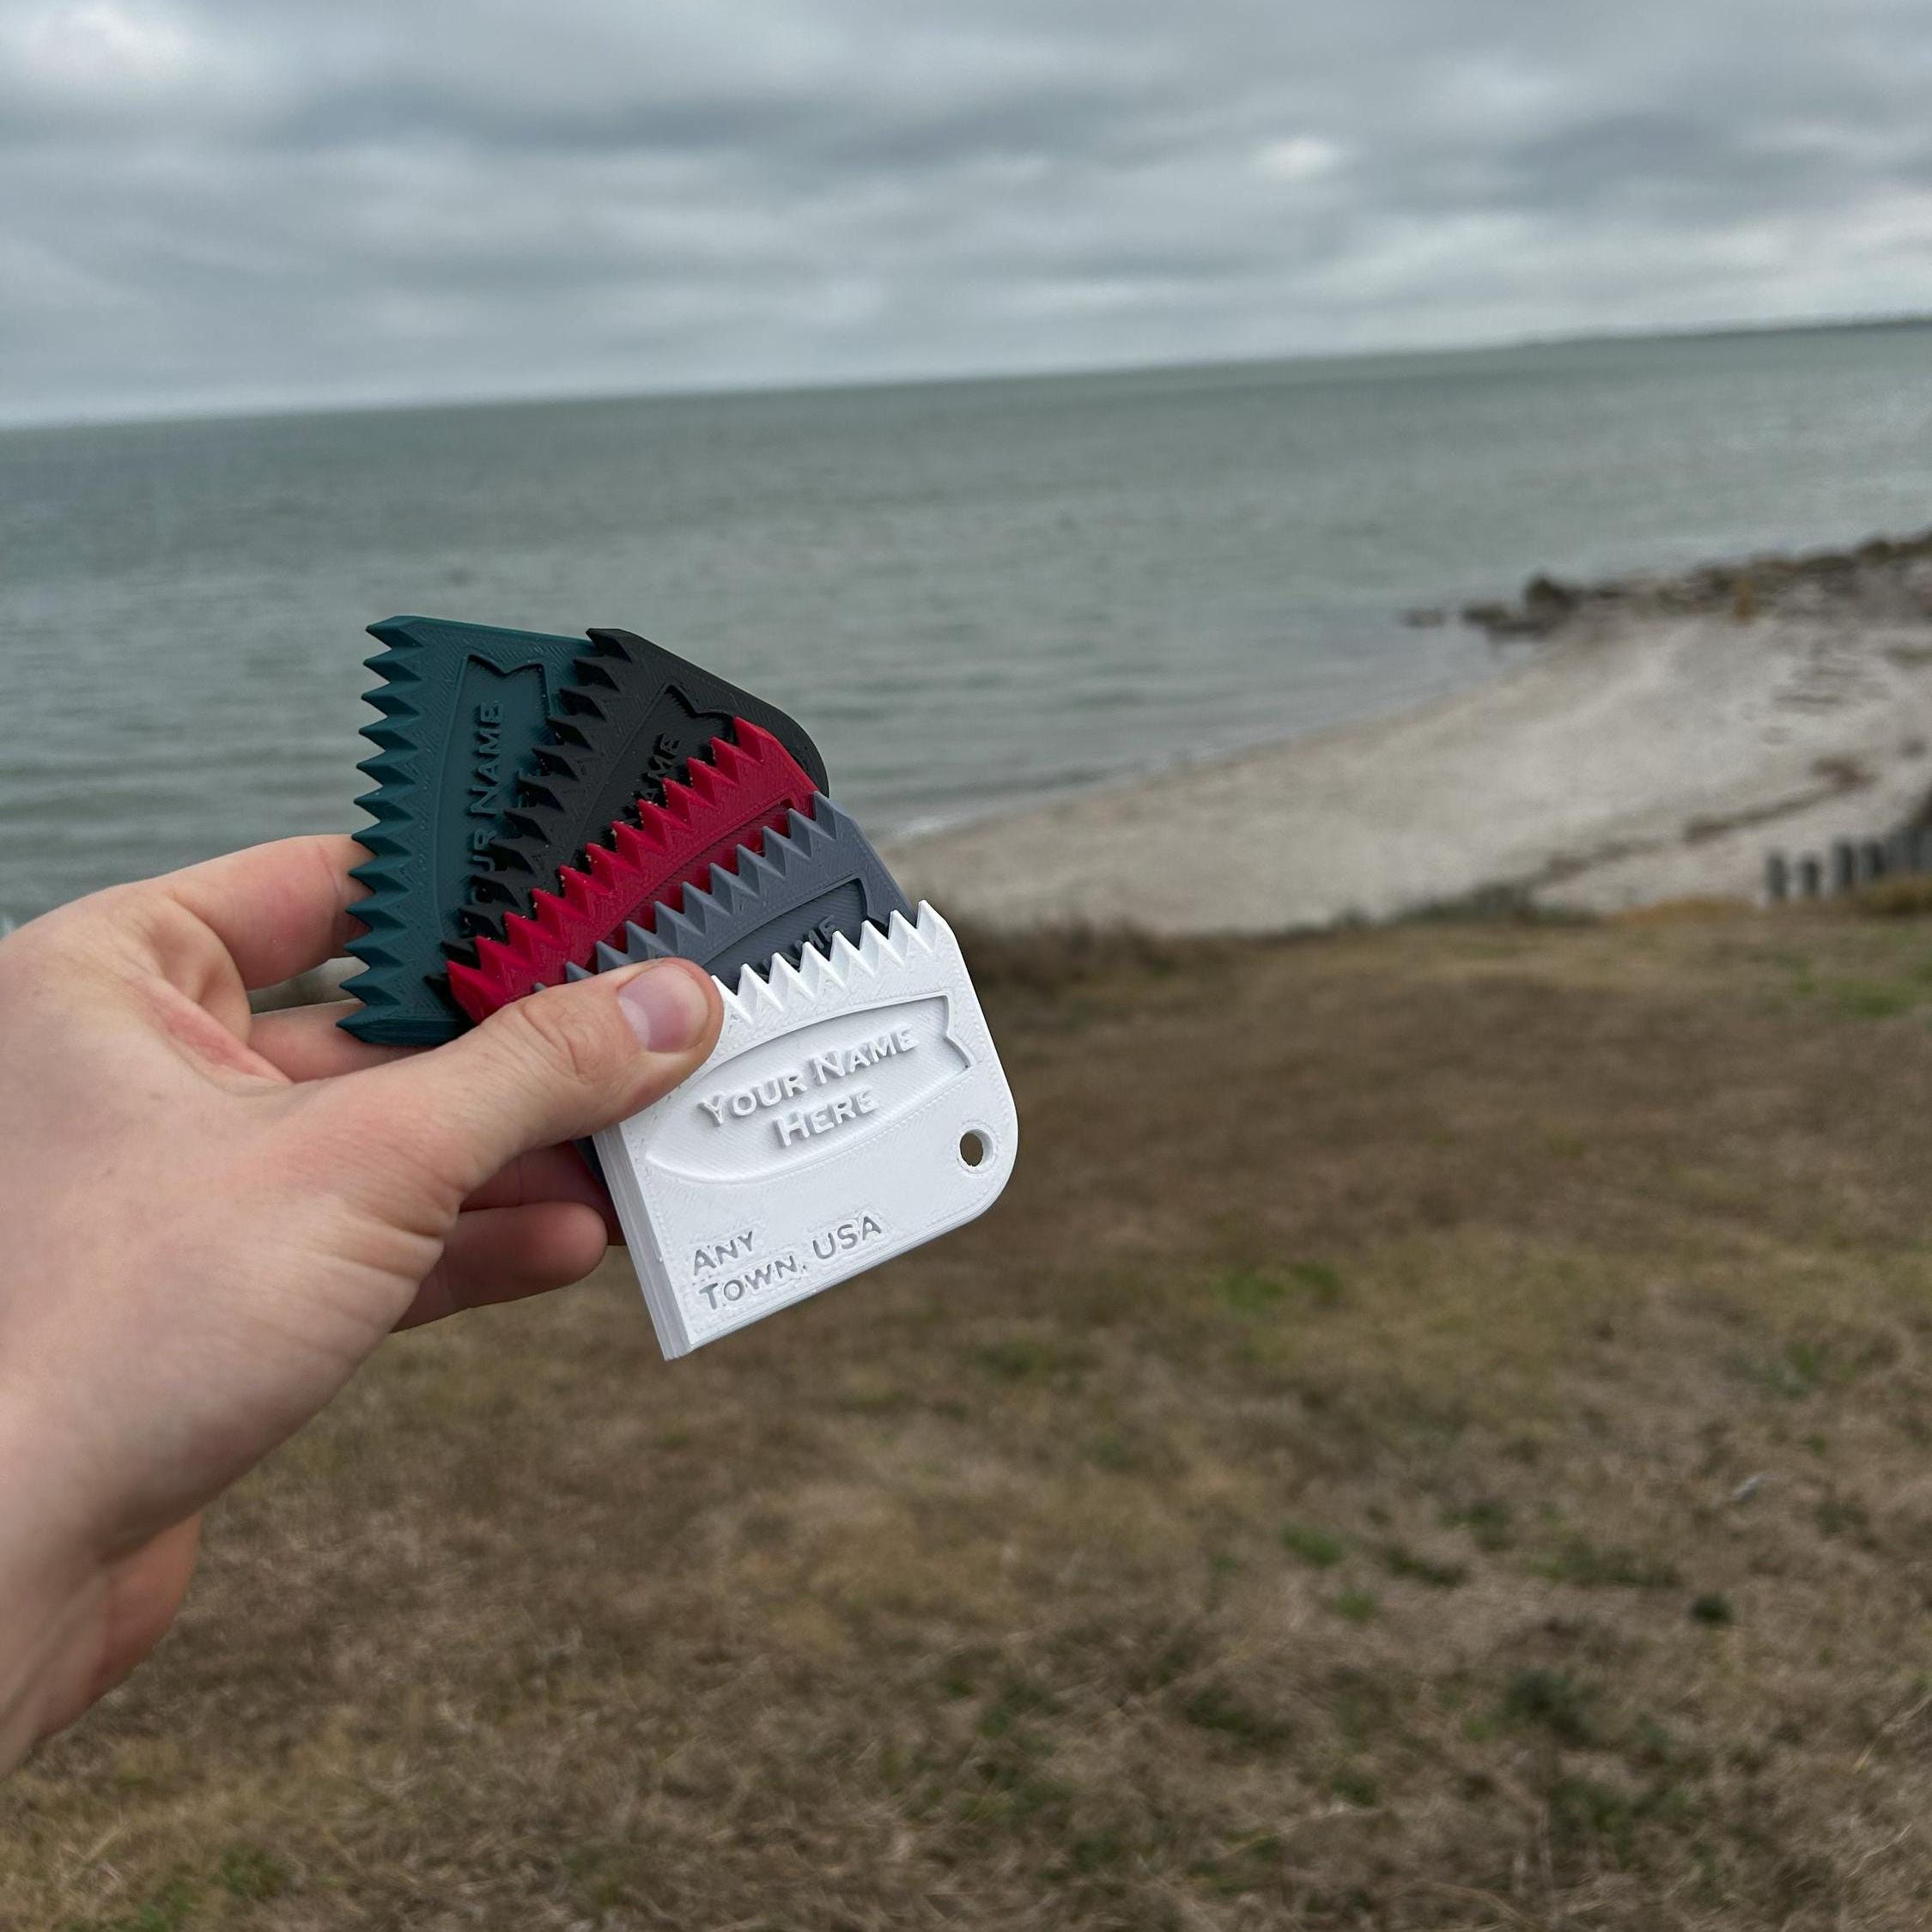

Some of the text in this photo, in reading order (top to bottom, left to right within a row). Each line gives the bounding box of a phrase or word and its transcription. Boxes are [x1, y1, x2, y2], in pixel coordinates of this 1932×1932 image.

[470, 700, 503, 815] NAME
[697, 1024, 920, 1127] YOUR NAME
[772, 1085, 879, 1148] HERE
[694, 1230, 753, 1276] ANY
[812, 1216, 883, 1260] USA
